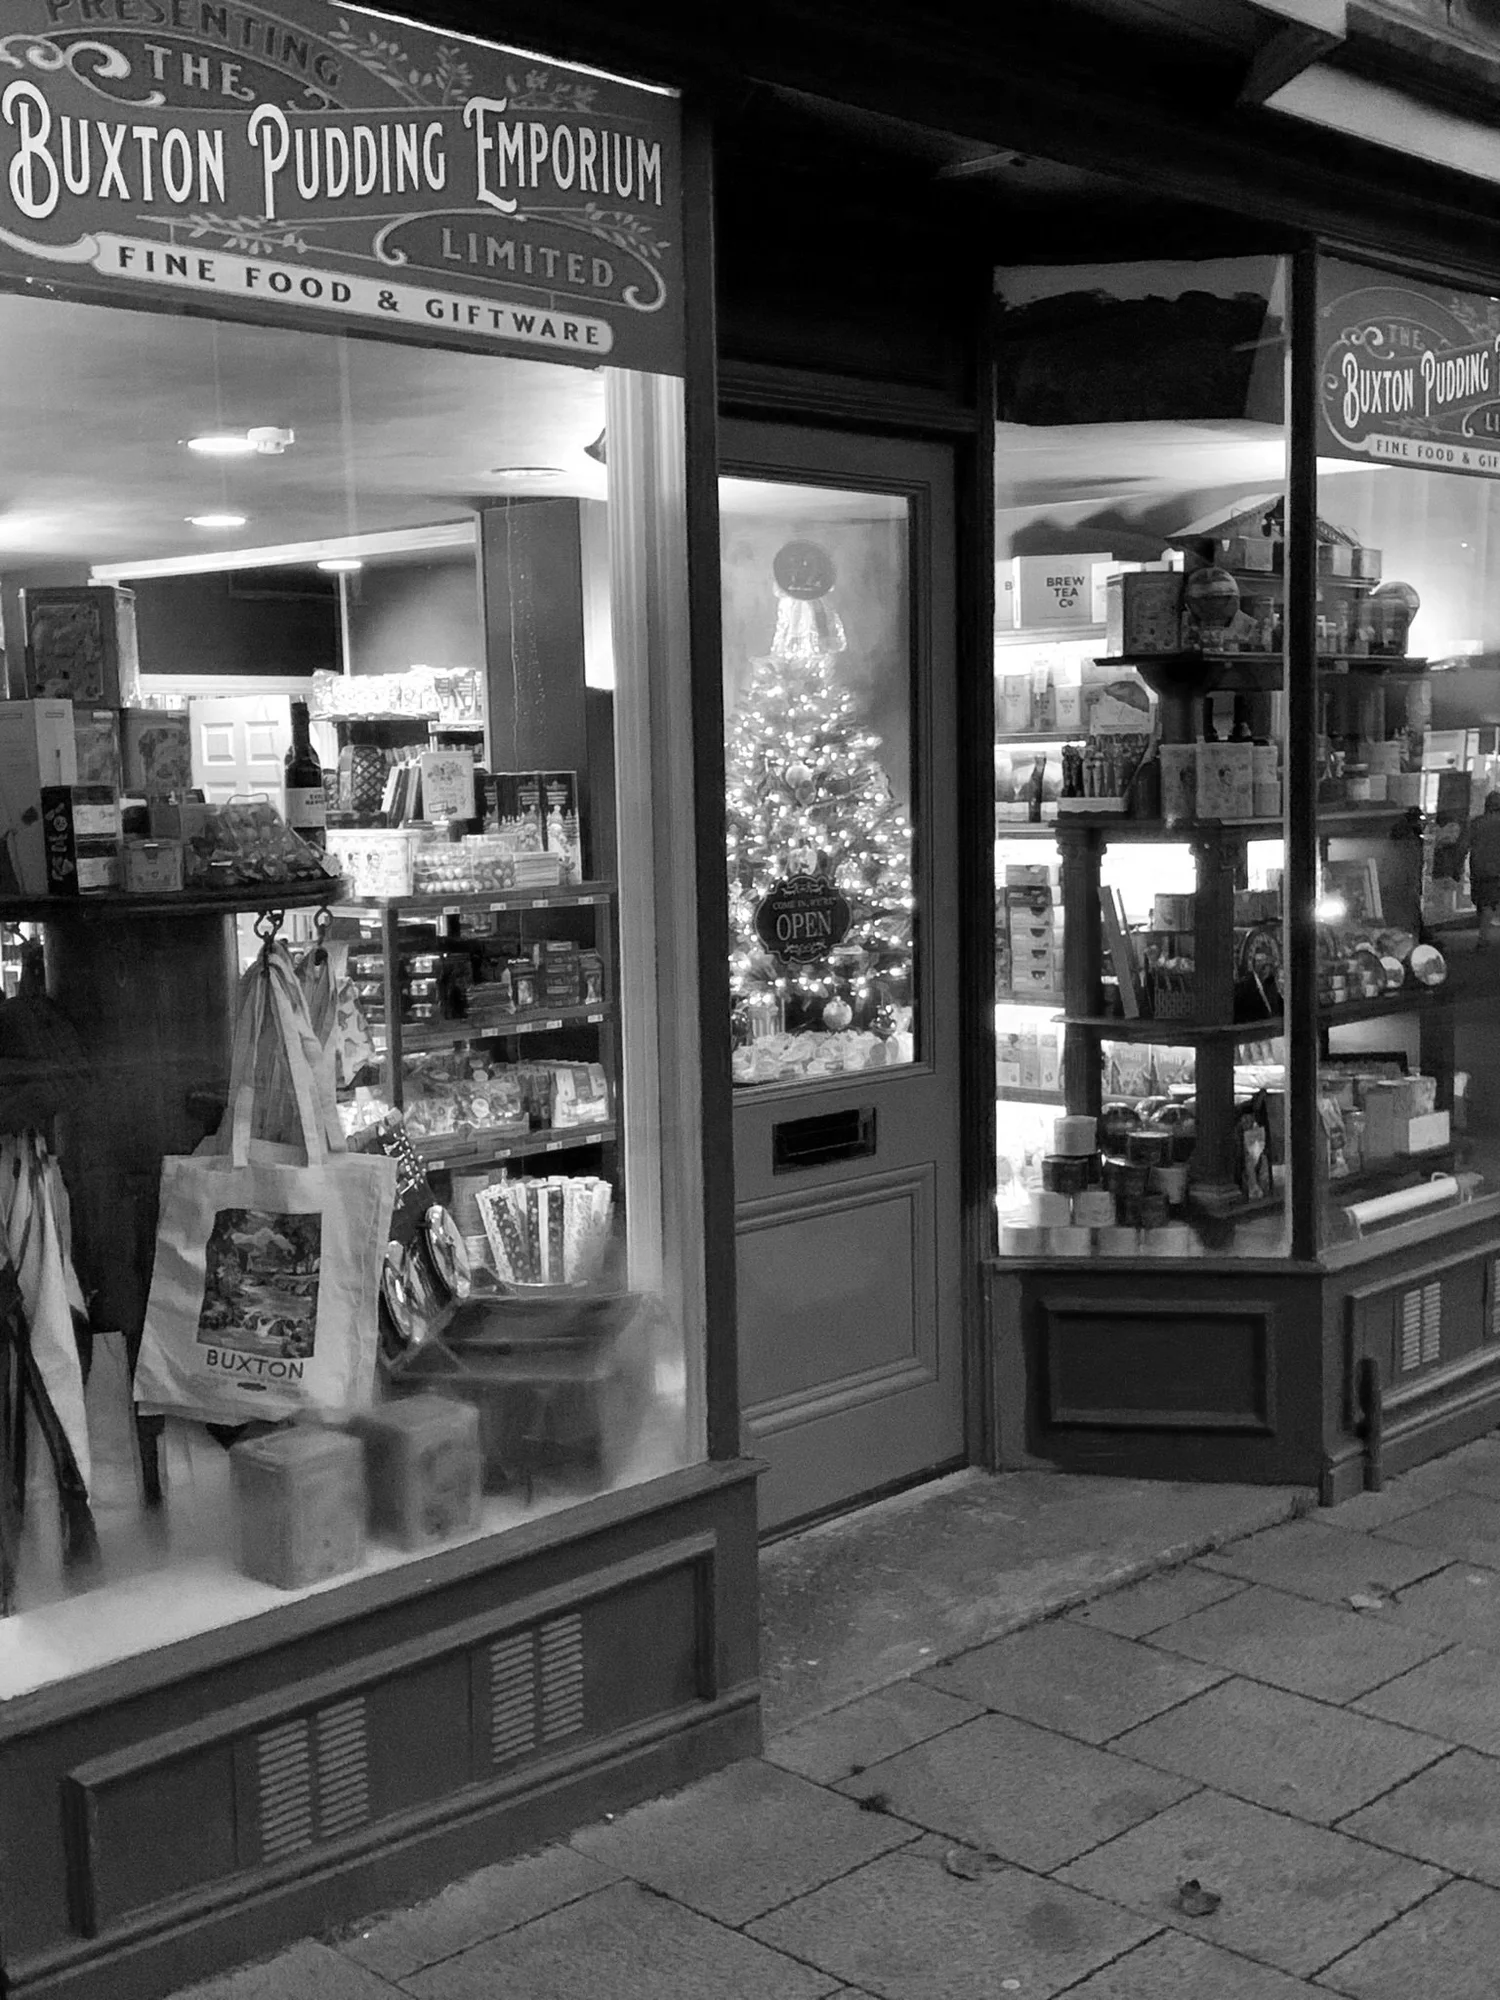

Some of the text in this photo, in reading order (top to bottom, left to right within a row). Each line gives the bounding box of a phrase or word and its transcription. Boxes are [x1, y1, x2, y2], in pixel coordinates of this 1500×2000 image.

[144, 43, 256, 102] THE
[441, 227, 614, 288] LIMITED
[118, 246, 602, 346] FINE FOOD & GIFTWARE
[1388, 324, 1426, 350] THE
[1376, 439, 1409, 456] FINE
[1417, 444, 1454, 461] FOOD
[1462, 452, 1470, 464] &
[1046, 576, 1085, 587] BREW
[1053, 587, 1079, 597] TEA
[777, 911, 831, 940] OPEN
[206, 1349, 304, 1379] BUXTON
